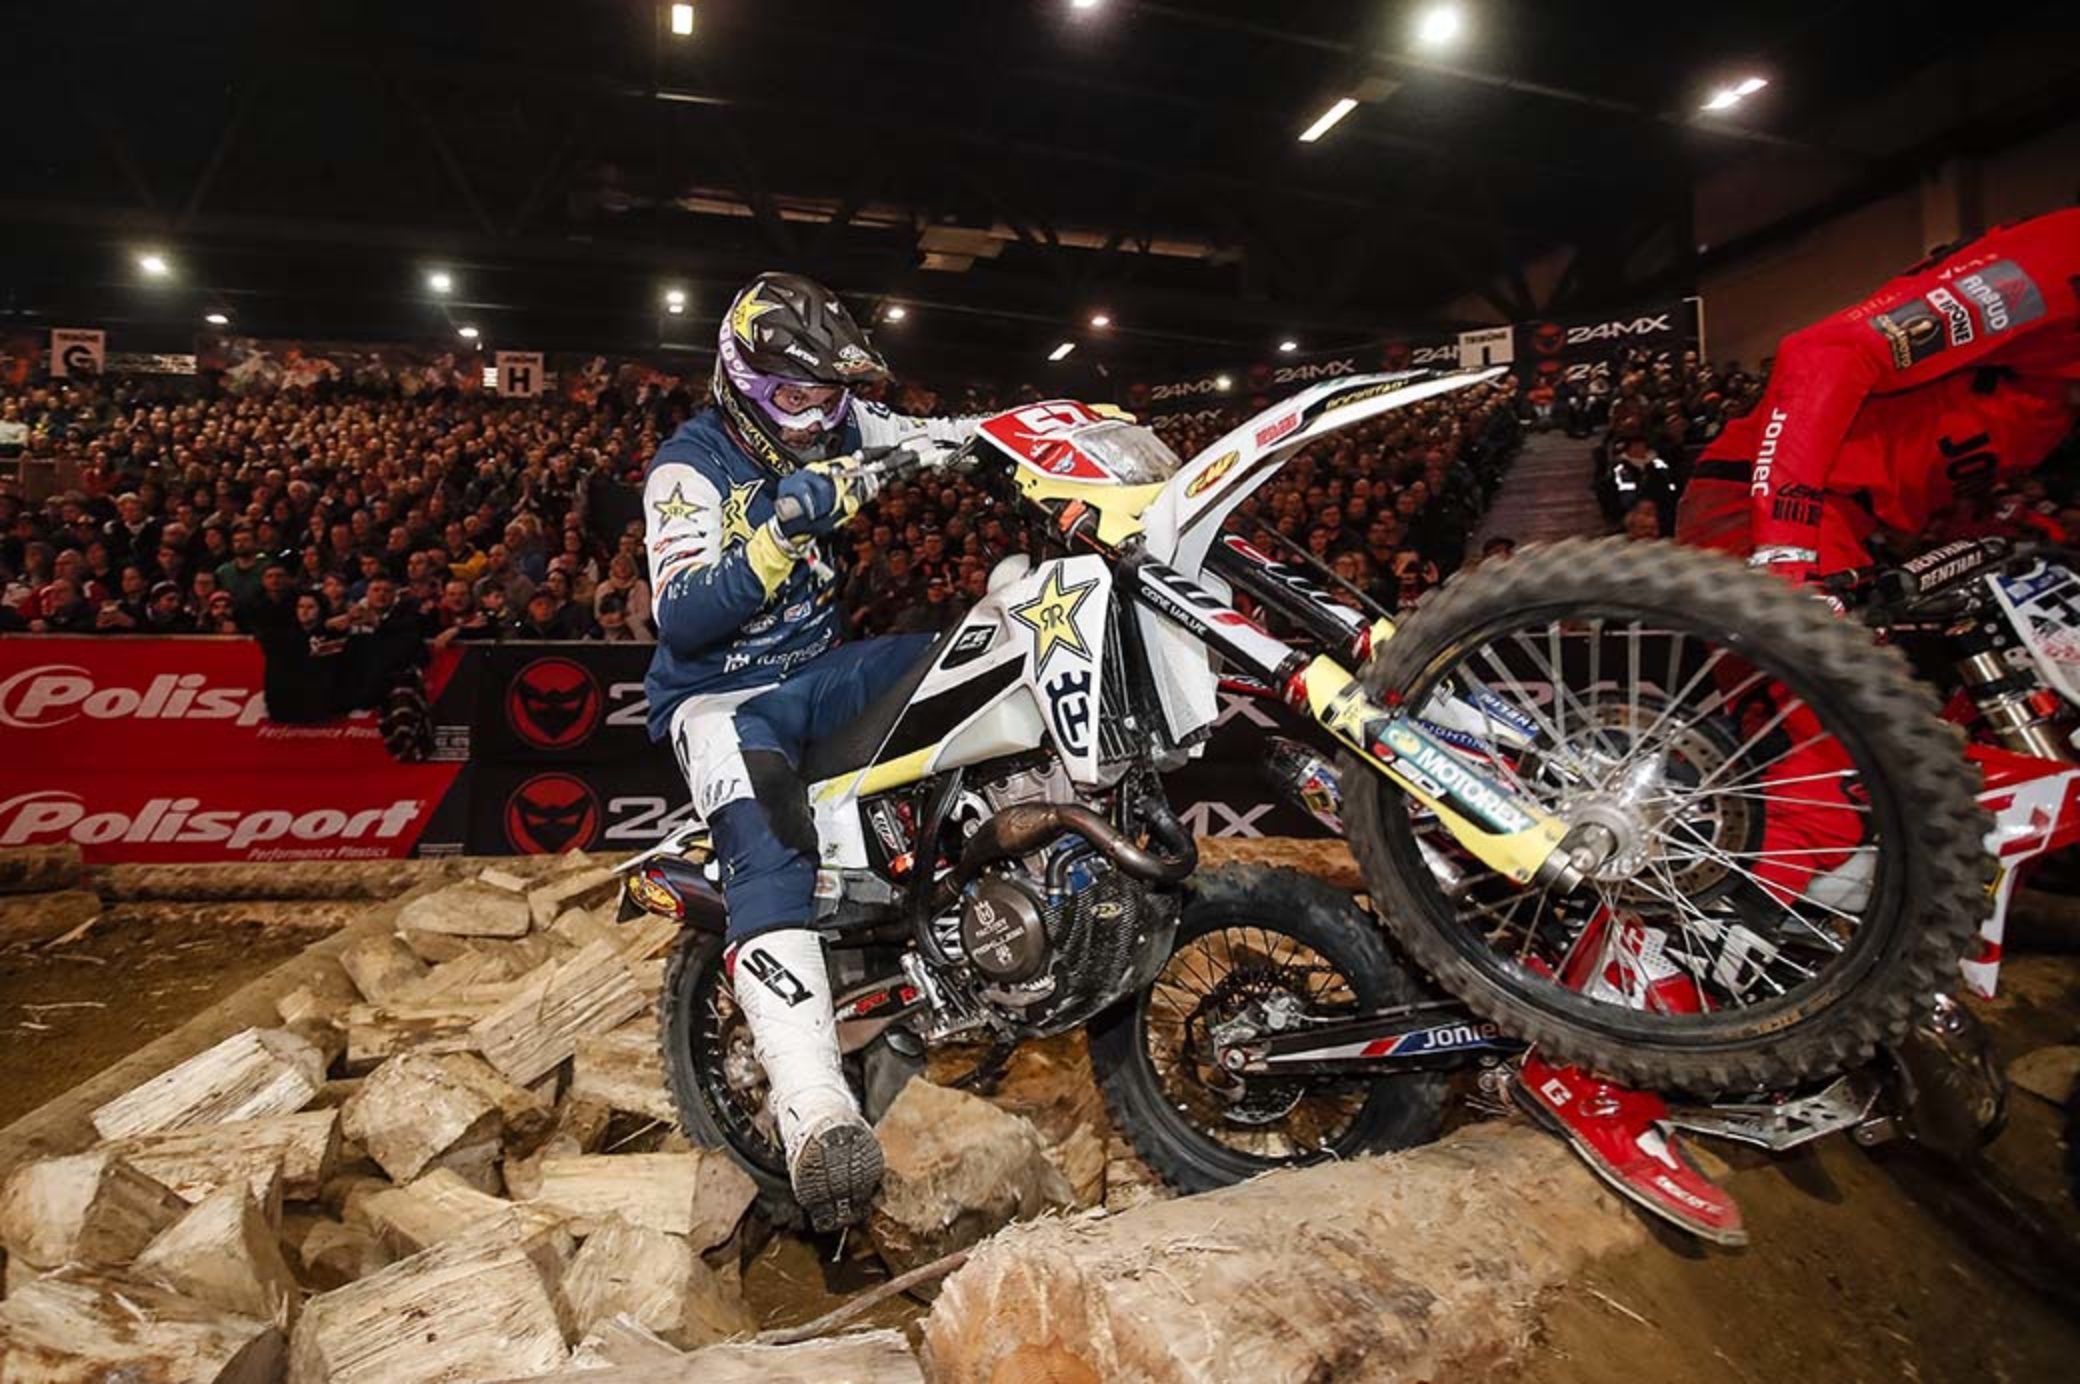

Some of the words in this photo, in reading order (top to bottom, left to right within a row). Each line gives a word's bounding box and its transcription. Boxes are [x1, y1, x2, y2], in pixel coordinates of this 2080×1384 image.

[1567, 314, 1671, 344] 24MX
[508, 367, 530, 392] H
[1274, 359, 1355, 383] 24MX
[14, 673, 269, 727] Polisp
[1416, 746, 1536, 834] MOTOREX
[1, 798, 419, 849] Polisport
